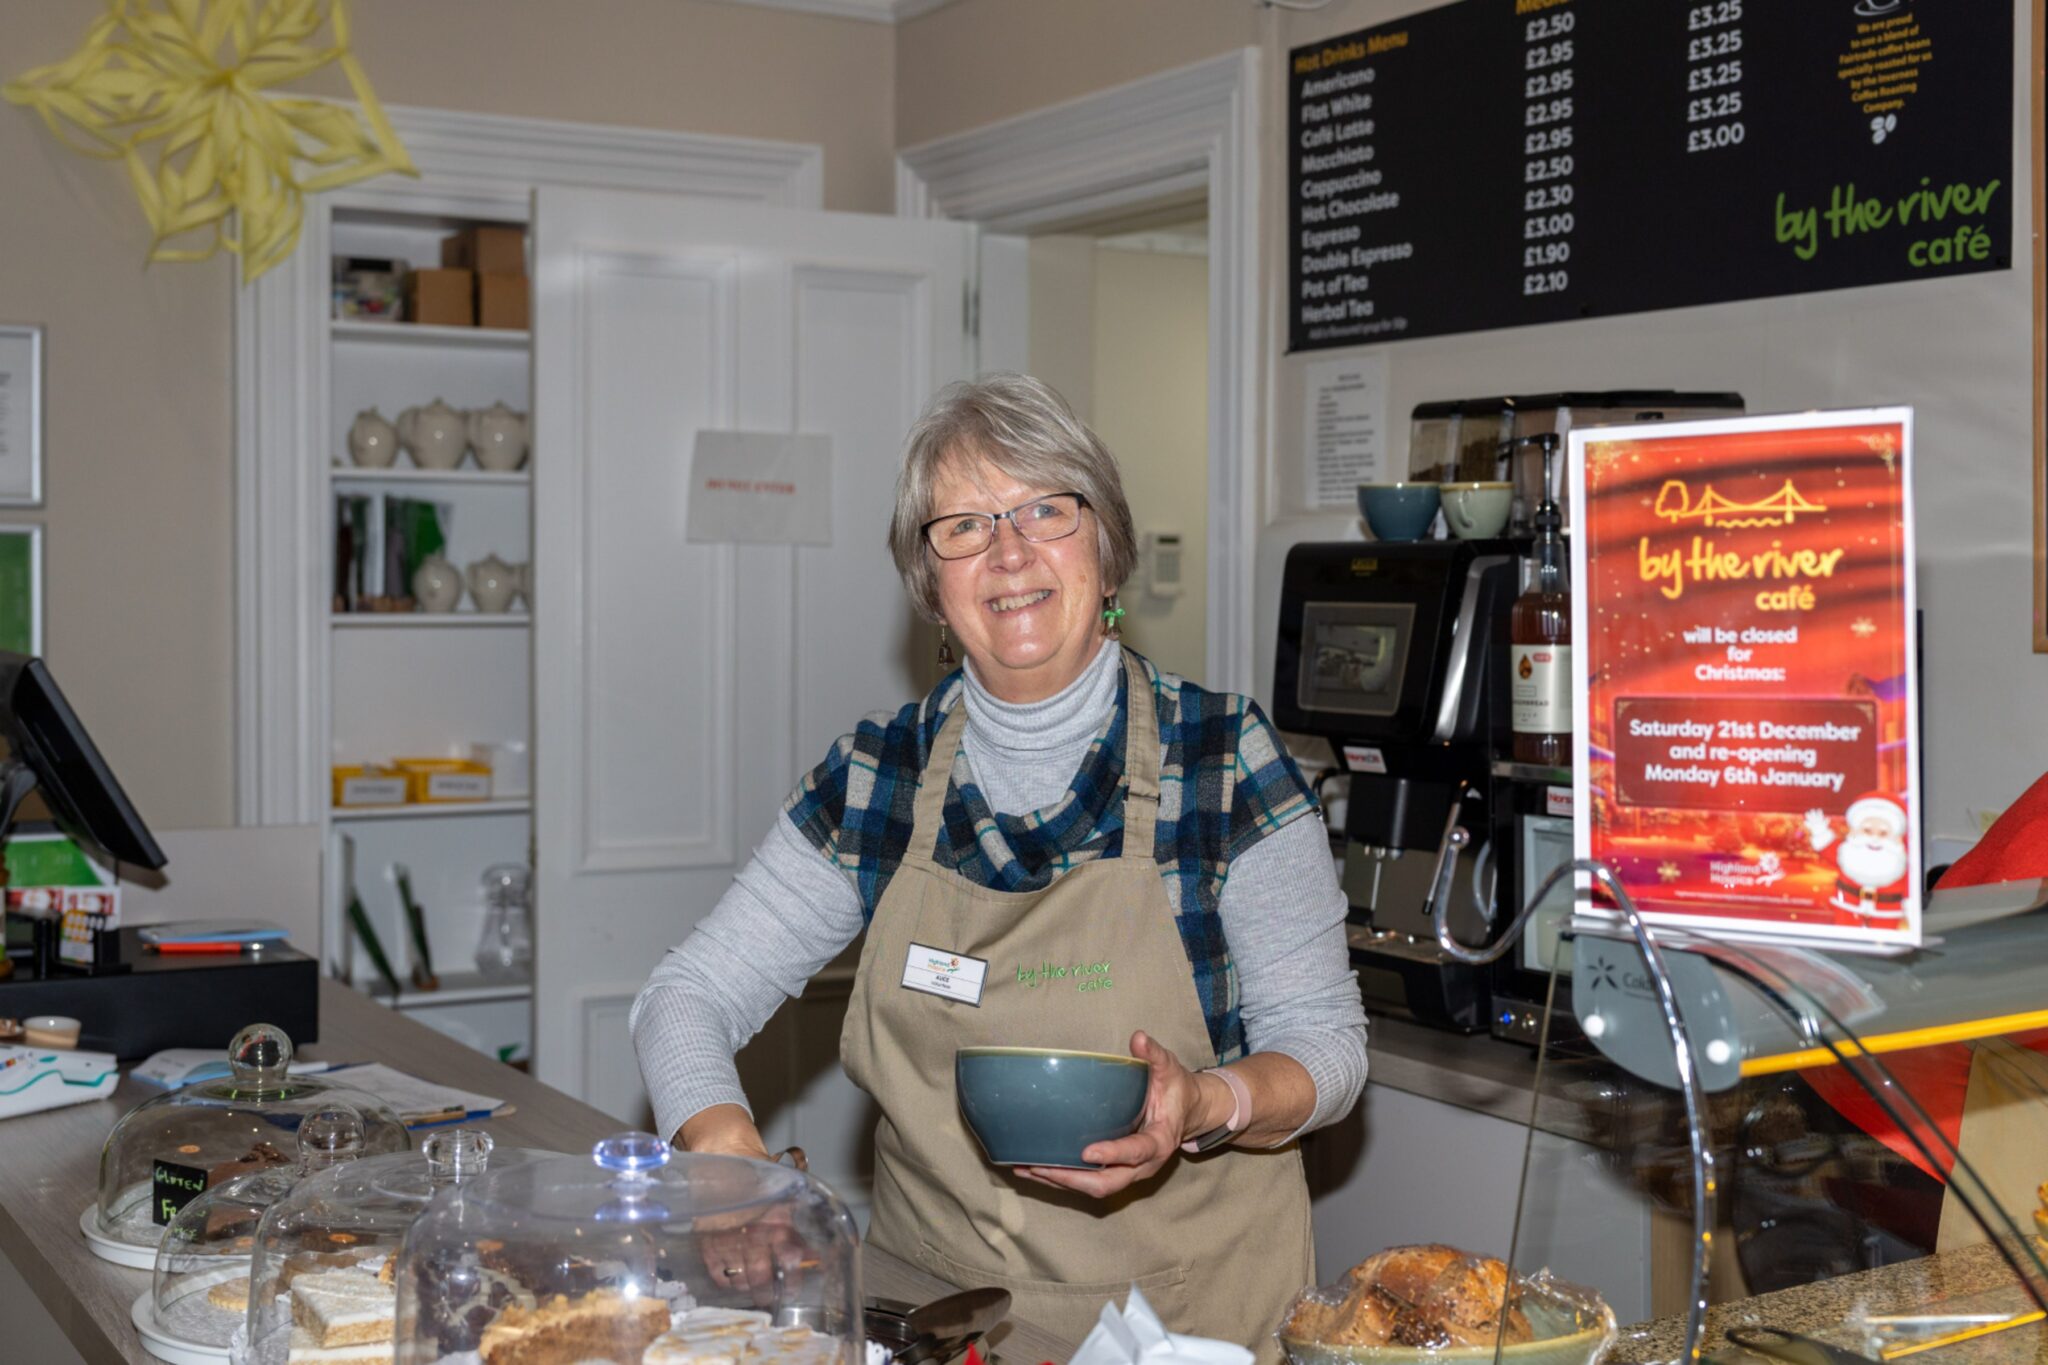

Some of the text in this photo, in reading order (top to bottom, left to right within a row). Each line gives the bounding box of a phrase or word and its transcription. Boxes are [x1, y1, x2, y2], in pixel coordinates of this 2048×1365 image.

[1525, 12, 1575, 42] £2.50
[1688, 0, 1743, 31] £3.25
[1525, 40, 1574, 70] £2.95
[1688, 30, 1743, 61] £3.25
[1302, 67, 1376, 98] Americano
[1525, 68, 1574, 98] £2.95
[1688, 60, 1743, 92] £3.25
[1302, 92, 1372, 124] Flat White
[1688, 92, 1743, 122] £3.25
[1852, 90, 1878, 103] Coffee
[1525, 98, 1574, 126] £2.95
[1302, 118, 1374, 148] Café Latte
[1525, 126, 1574, 154] £2.95
[1687, 122, 1745, 153] £3.00
[1525, 155, 1574, 183] £2.50
[1302, 168, 1382, 199] Cappuccino
[1524, 184, 1574, 211] £2.30
[1302, 192, 1400, 224] Hot Chocolate
[1775, 177, 2000, 260] by the river
[1302, 226, 1361, 251] Espresso
[1524, 213, 1574, 239] £3.00
[1302, 242, 1413, 274] Double Espresso
[1524, 242, 1570, 268] £1.90
[1908, 225, 1991, 268] café
[1302, 274, 1368, 298] Pot of Tea
[1524, 270, 1568, 296] £2.10
[1302, 298, 1374, 324] Herbal Tea
[1640, 535, 1844, 599] by the river
[1755, 584, 1816, 611] café
[1683, 626, 1798, 644] will be closed
[1726, 645, 1753, 663] for
[1694, 663, 1786, 682] Christmas:
[1629, 718, 1861, 743] Saturday 21st December
[1669, 742, 1817, 768] and re-opening
[1644, 764, 1845, 792] Monday 6th January
[1710, 861, 1760, 876] Highland
[1016, 959, 1111, 988] by the river
